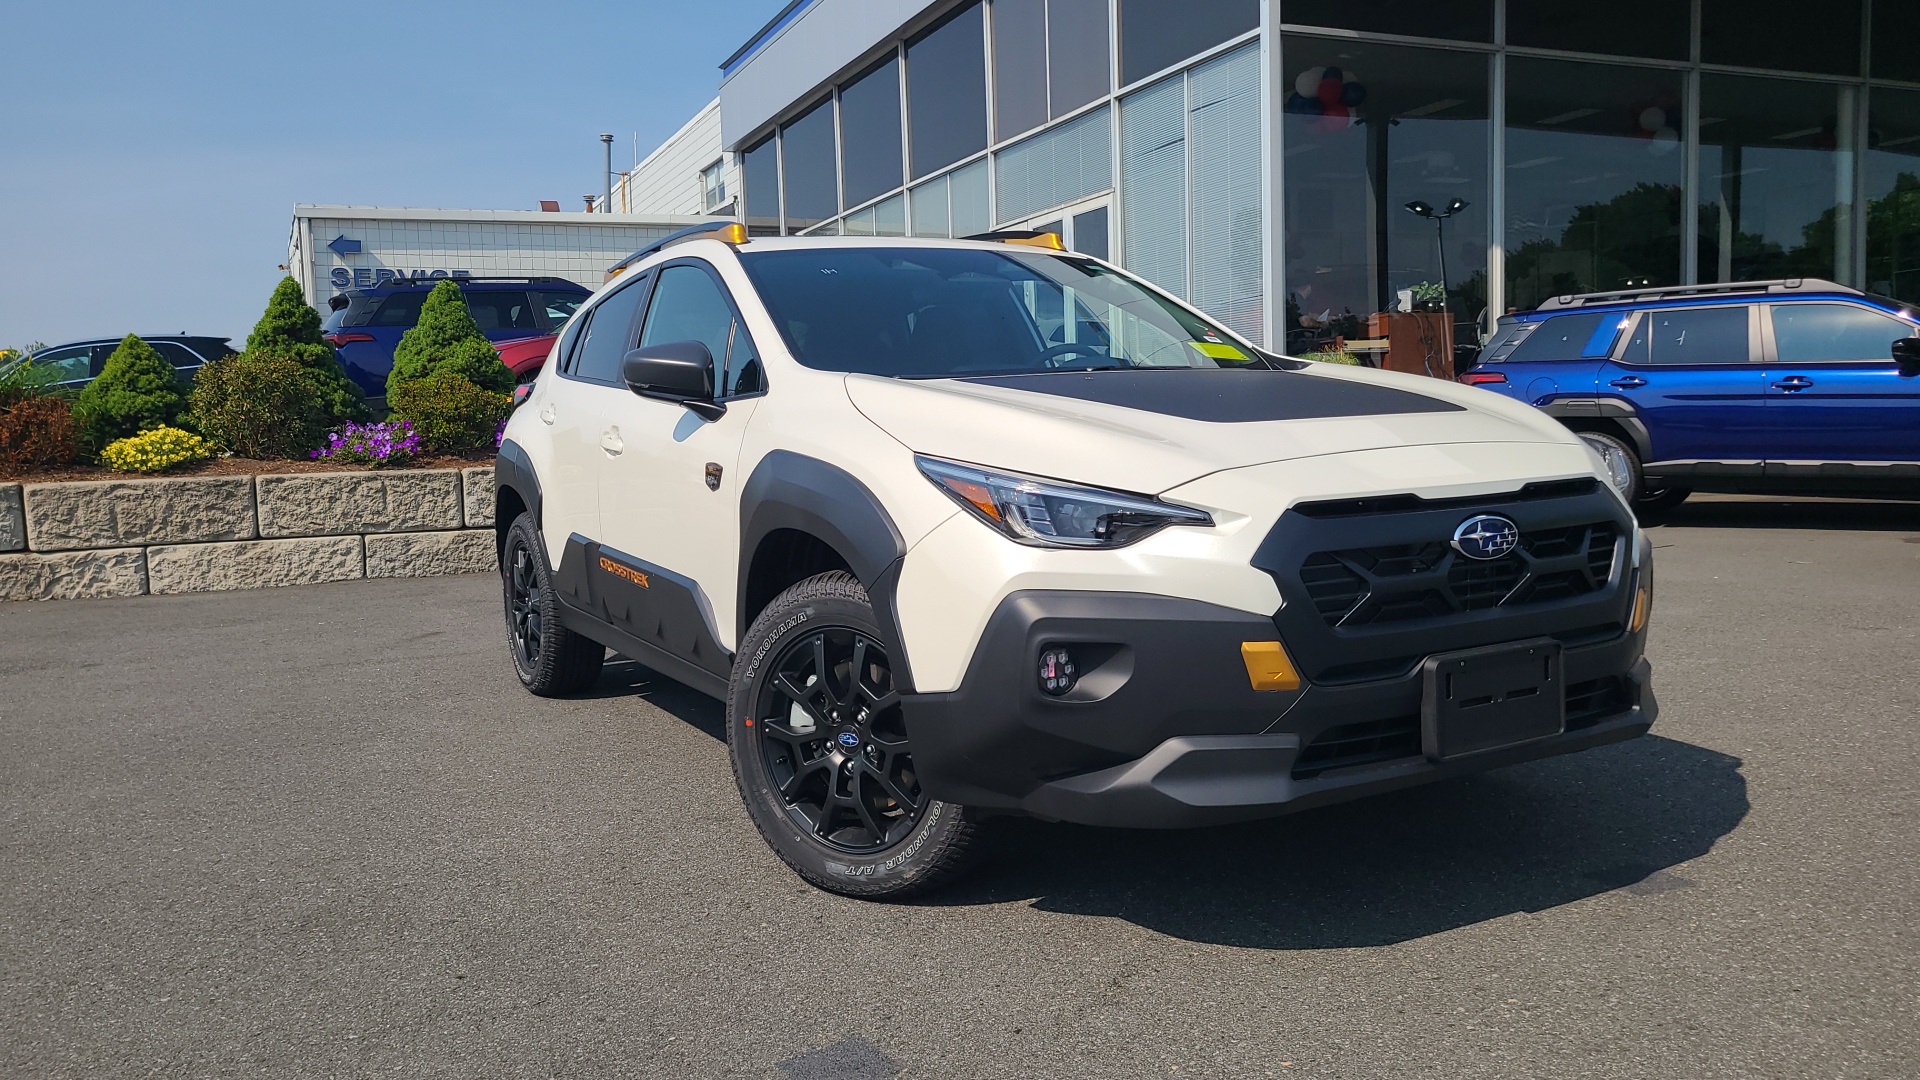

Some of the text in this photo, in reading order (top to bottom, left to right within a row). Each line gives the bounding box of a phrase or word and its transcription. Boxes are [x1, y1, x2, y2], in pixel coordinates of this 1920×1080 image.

[599, 556, 650, 589] CROSSTREK
[746, 612, 808, 678] YOKOHAMA
[844, 864, 876, 876] A/T
